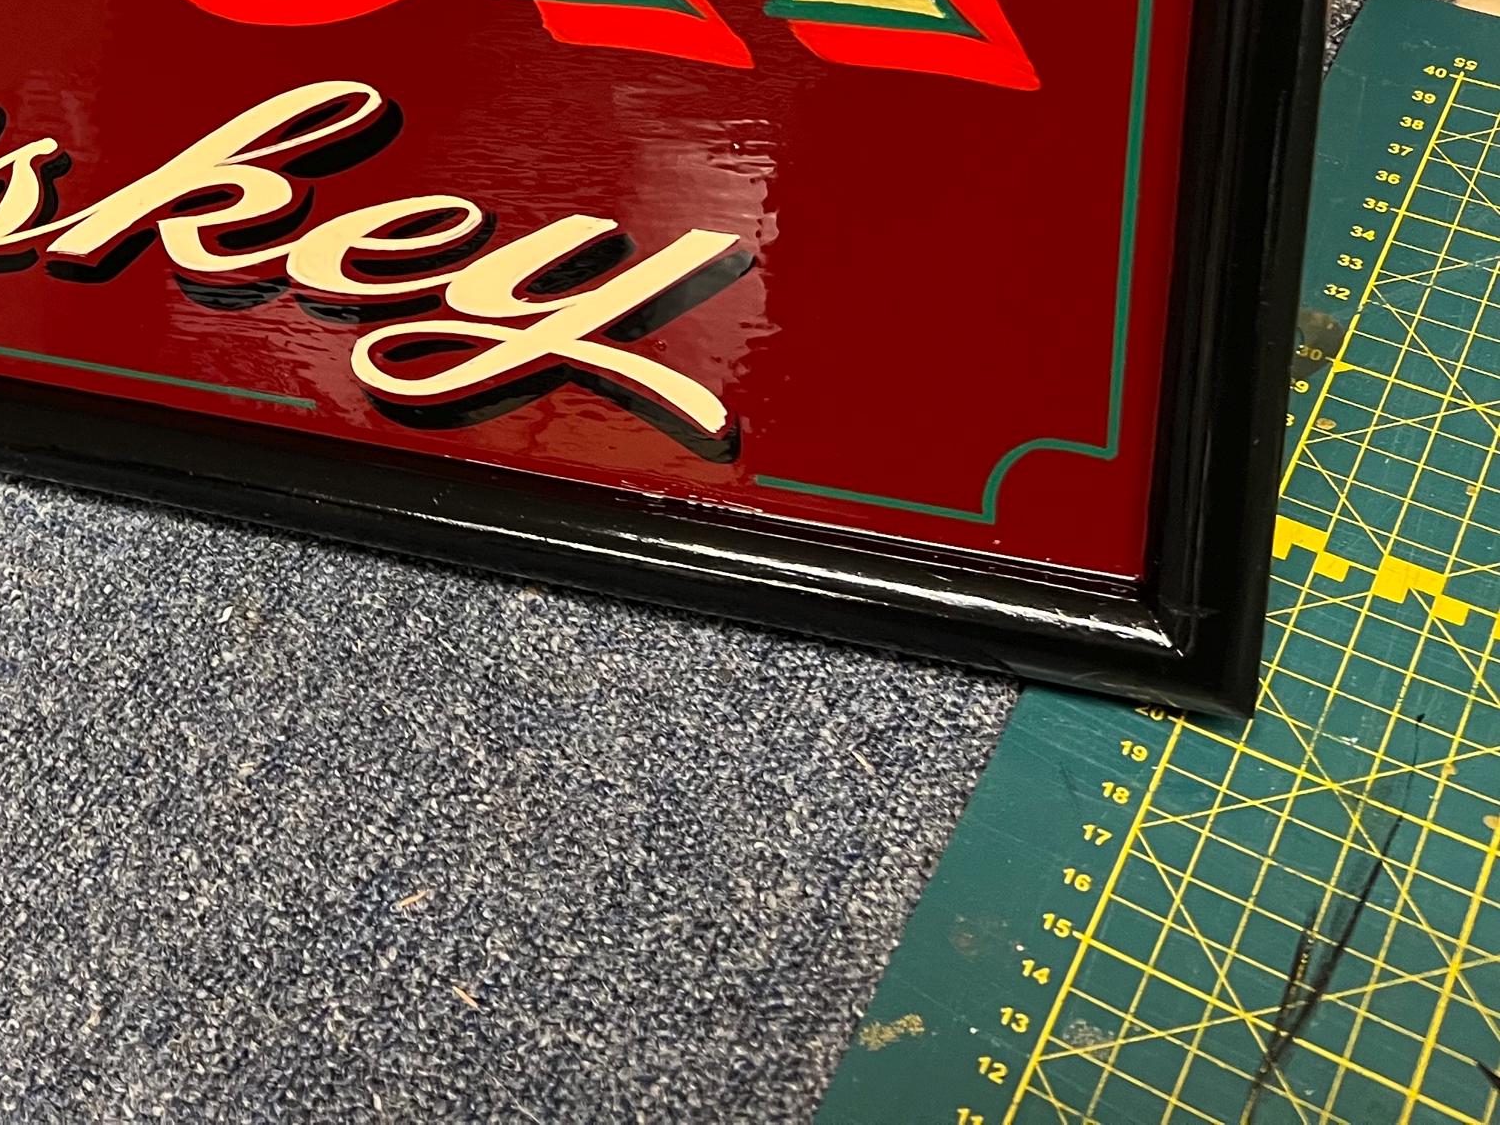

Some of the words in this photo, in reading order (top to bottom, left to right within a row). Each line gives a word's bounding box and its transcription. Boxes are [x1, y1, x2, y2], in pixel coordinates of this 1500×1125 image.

[1422, 64, 1448, 78] 40
[1411, 89, 1437, 105] 39
[1399, 116, 1425, 131] 38
[1387, 142, 1414, 157] 37
[1375, 169, 1401, 185] 36
[1362, 196, 1389, 214] 35
[1350, 225, 1376, 241] 34
[1336, 253, 1364, 270] 33
[1323, 283, 1351, 301] 32
[1296, 344, 1323, 361] 30
[1120, 740, 1148, 762] 19
[1101, 781, 1131, 804] 18
[1082, 824, 1113, 846] 17
[1062, 868, 1093, 892] 16
[1042, 912, 1073, 938] 15
[1021, 959, 1051, 985] 14
[1000, 1007, 1030, 1033] 13
[977, 1056, 1008, 1085] 12
